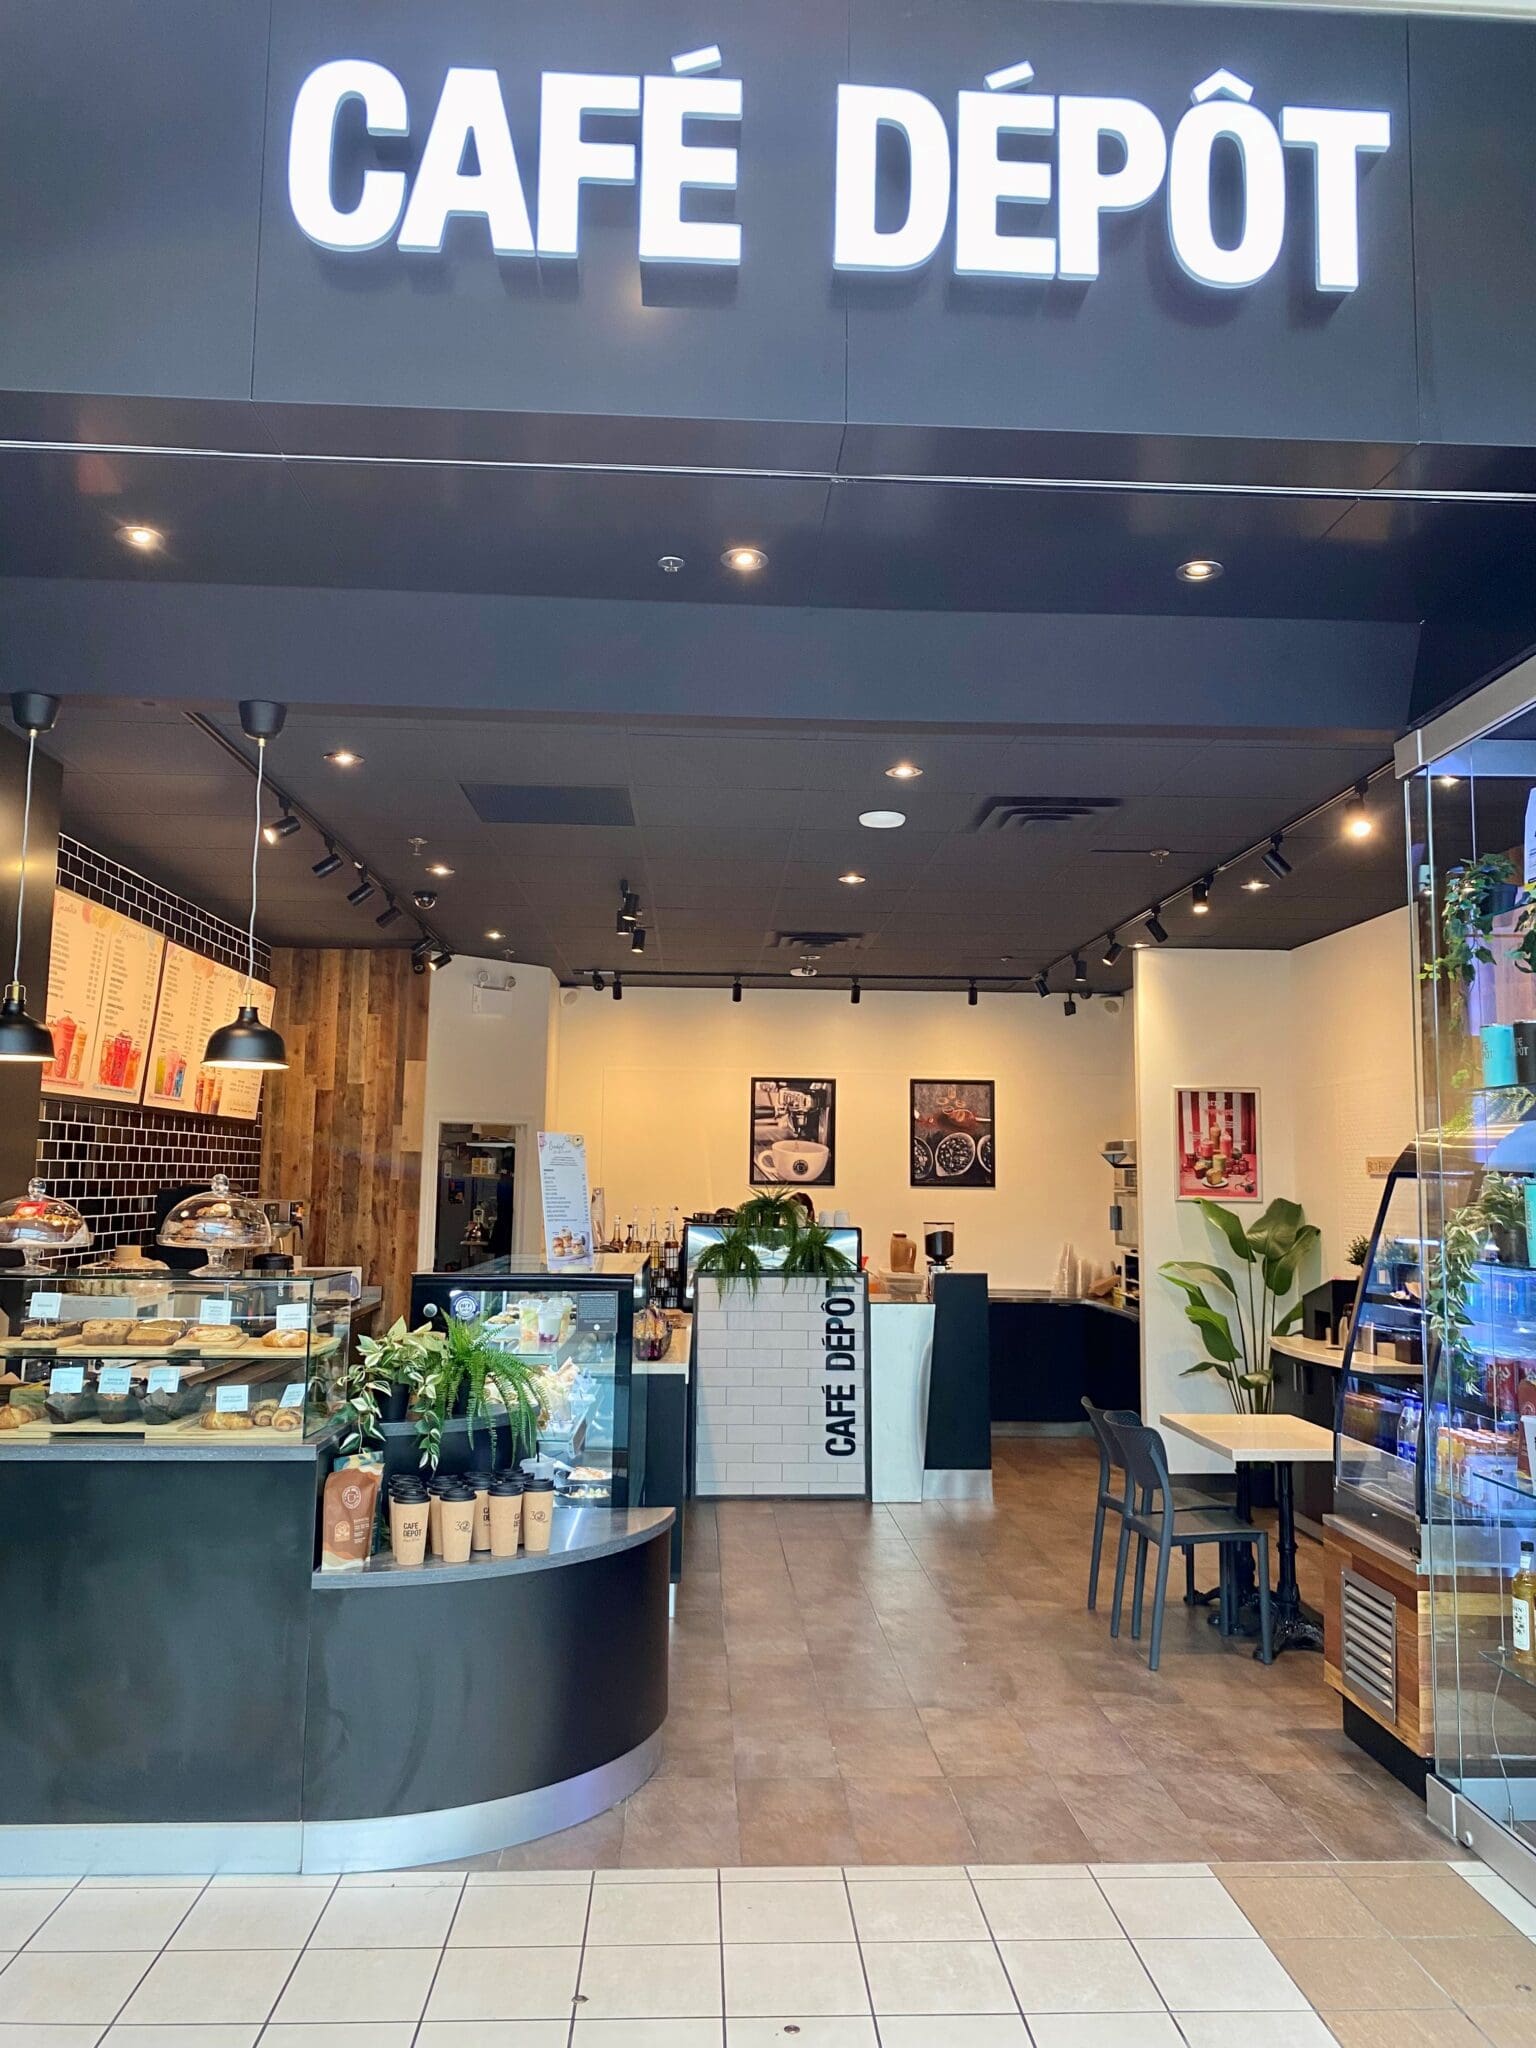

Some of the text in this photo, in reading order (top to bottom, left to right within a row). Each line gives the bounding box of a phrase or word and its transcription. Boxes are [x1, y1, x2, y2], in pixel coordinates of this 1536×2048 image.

[287, 44, 1392, 293] CAFÉ DÉPÔT
[820, 1280, 856, 1457] CAFÉ DÉPÔT
